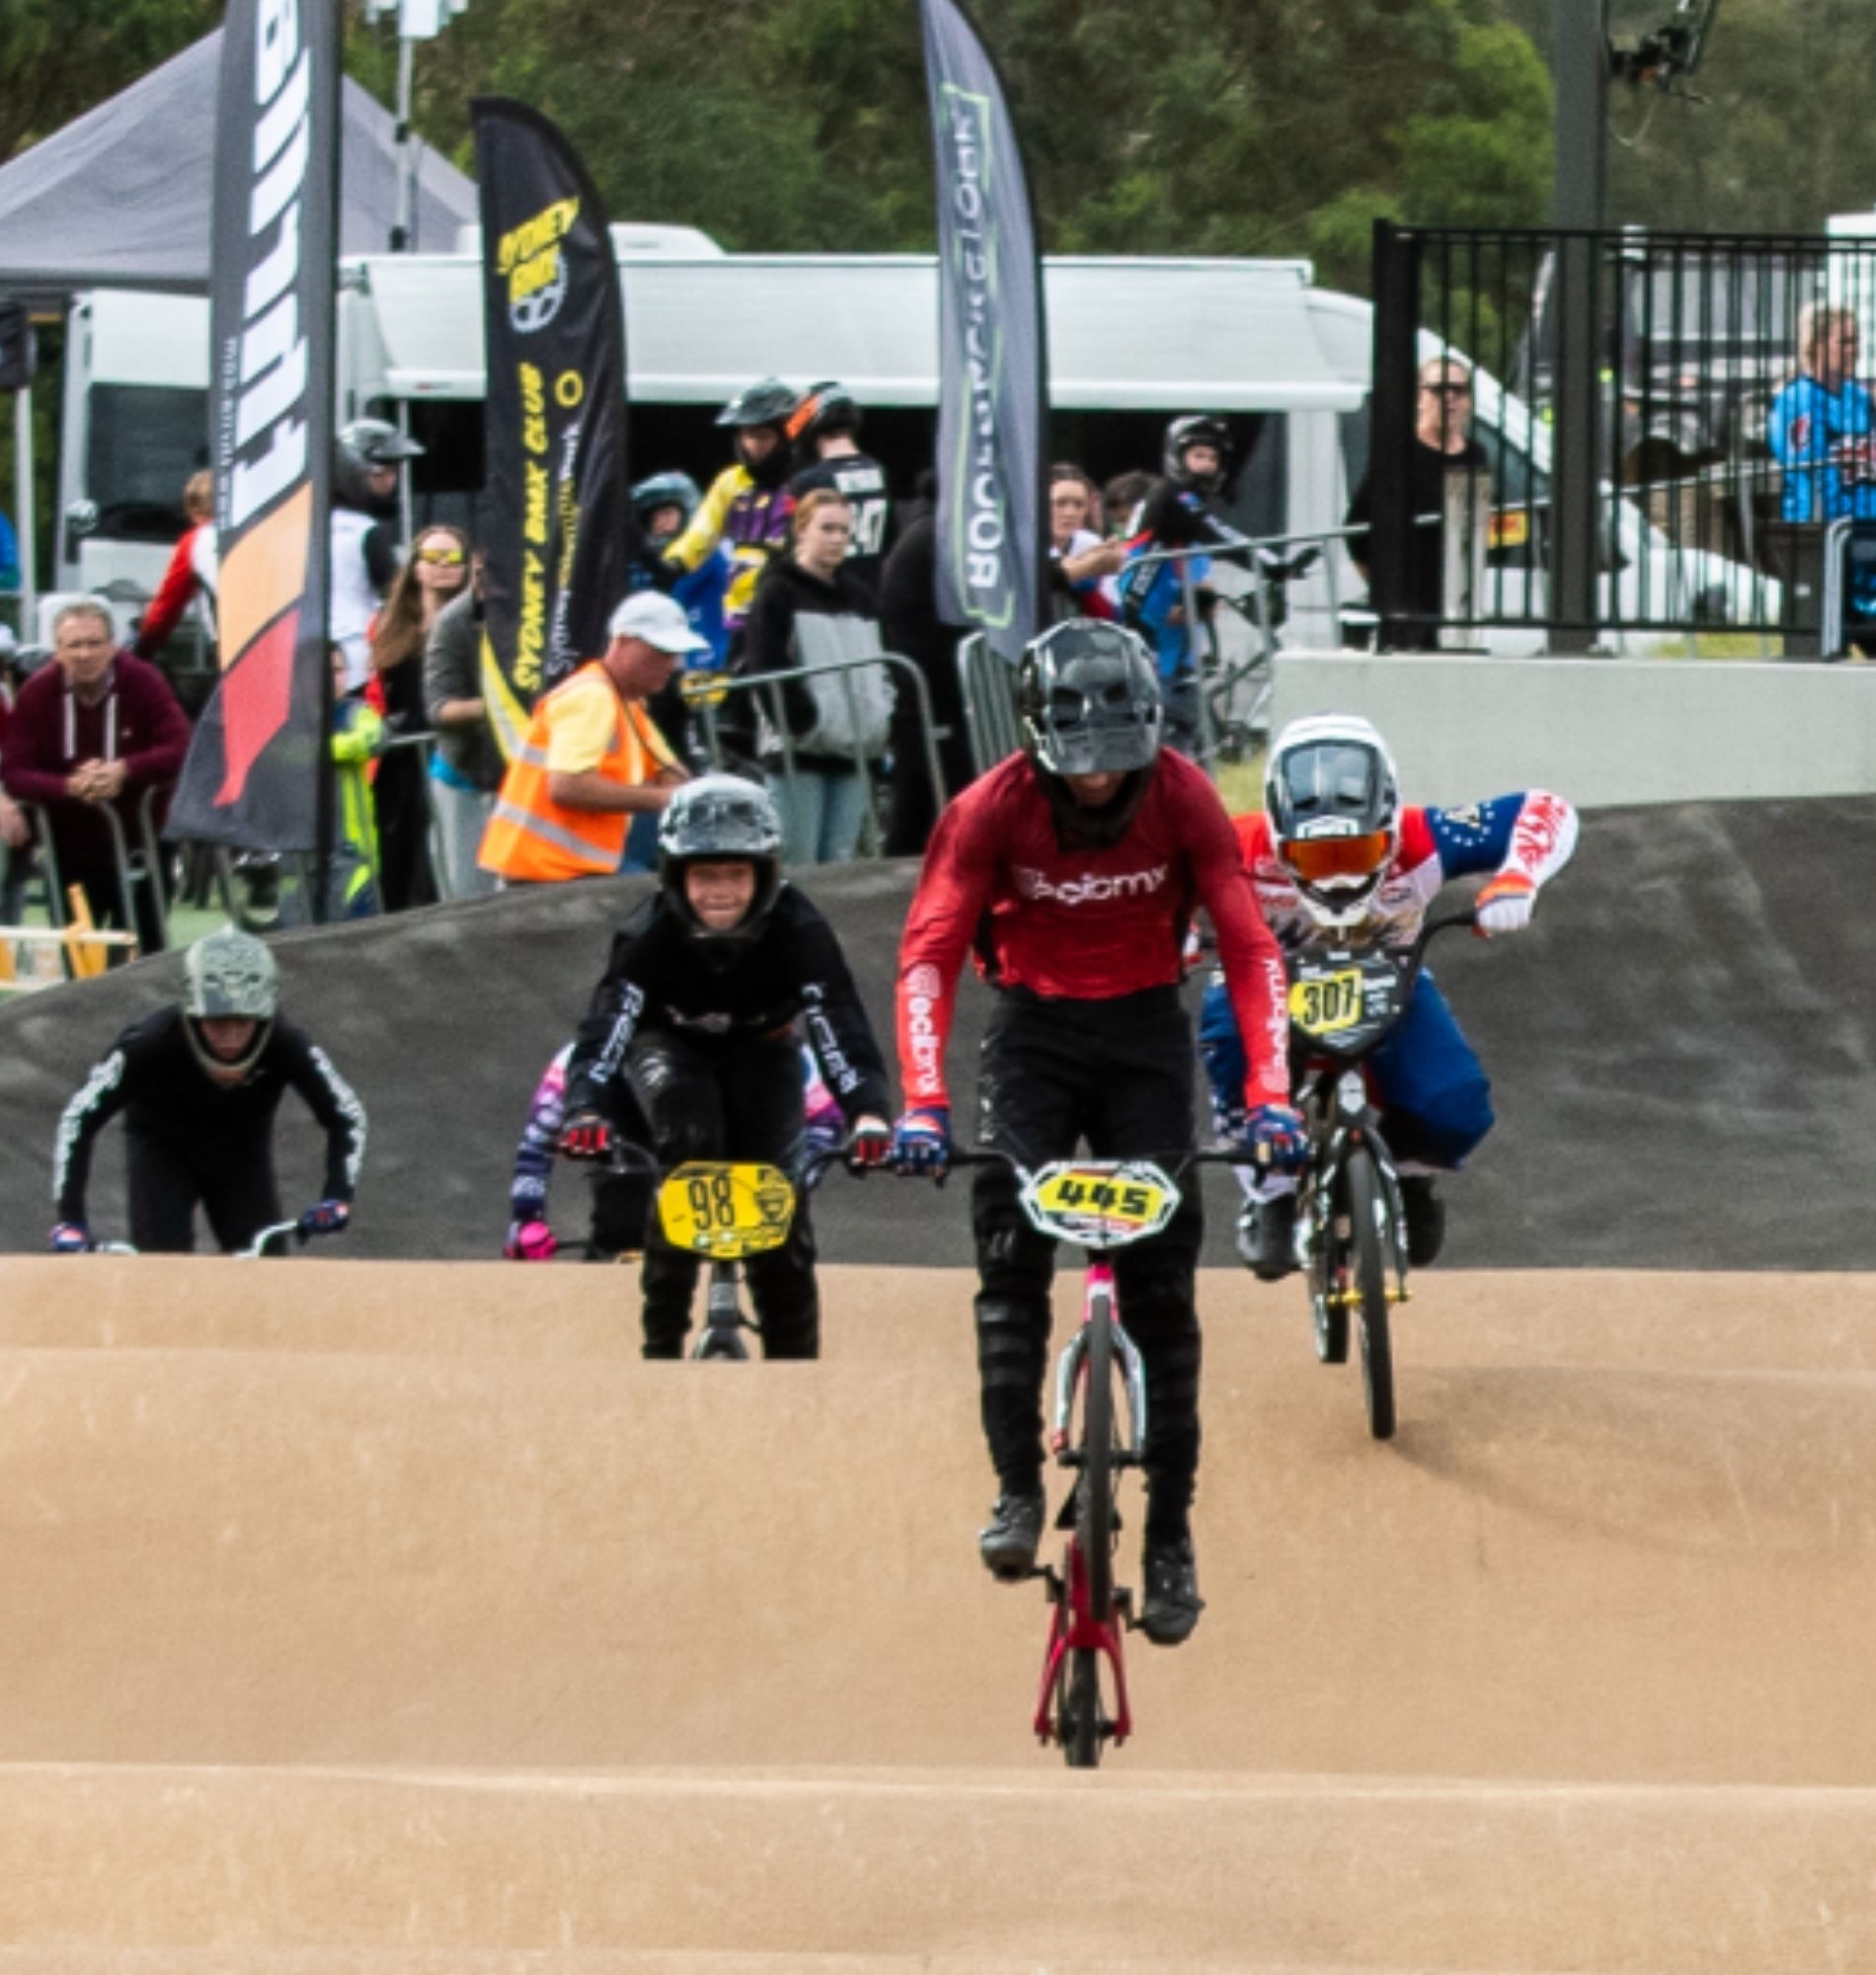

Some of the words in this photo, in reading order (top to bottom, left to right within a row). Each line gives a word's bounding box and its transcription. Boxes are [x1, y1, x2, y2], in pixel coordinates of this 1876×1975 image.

[519, 361, 548, 454] CLUB
[523, 458, 548, 543] BMX
[513, 548, 544, 690] SYDNEY
[1302, 977, 1355, 1025] 307
[687, 1172, 735, 1230] 98
[1055, 1179, 1149, 1216] 445
